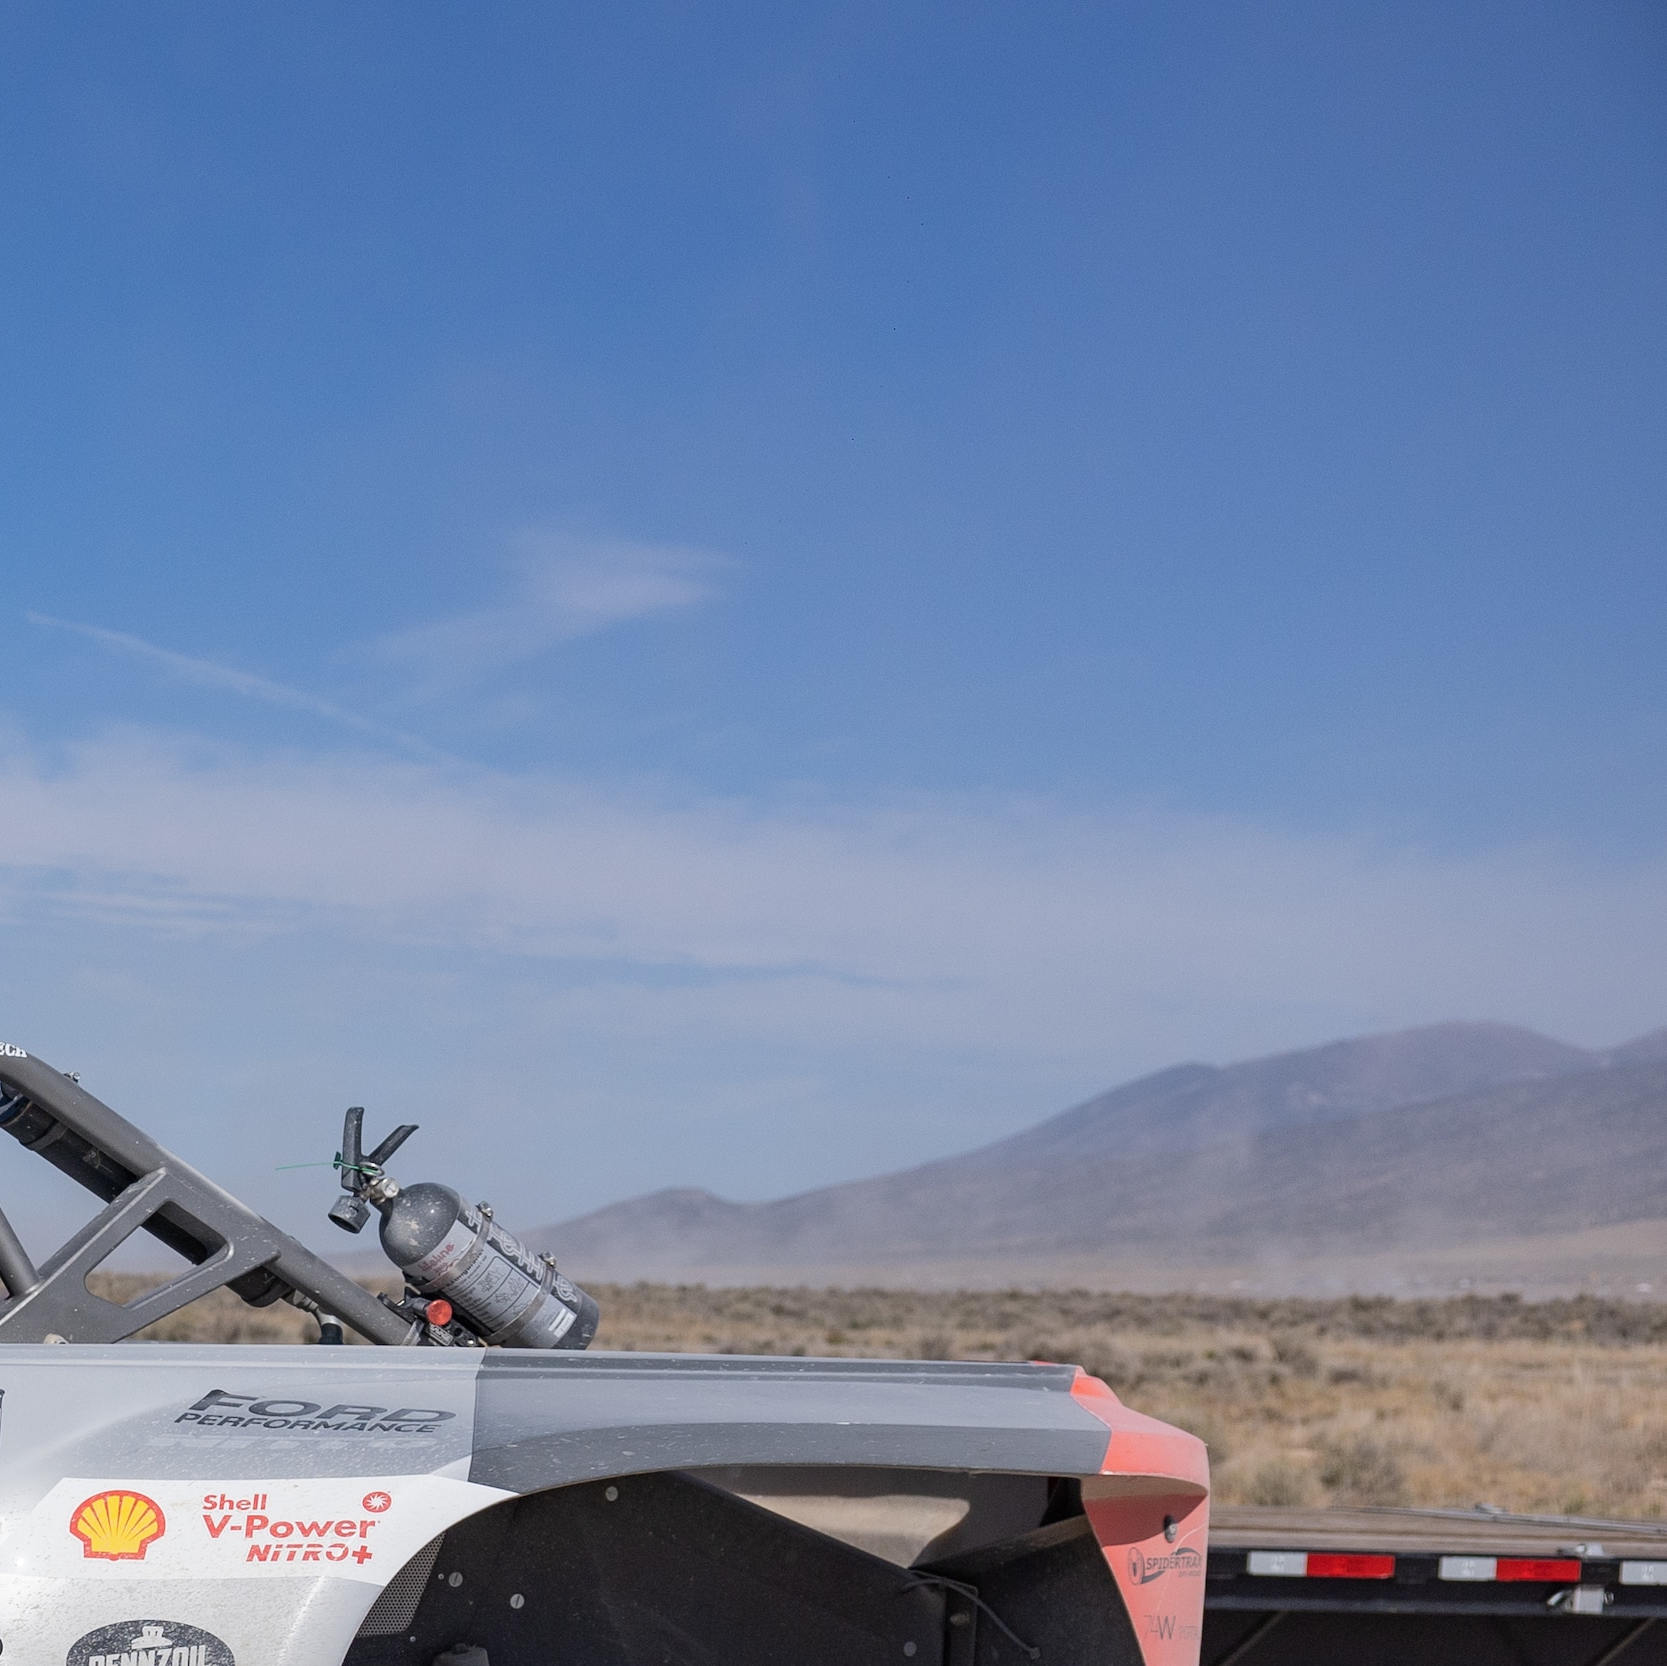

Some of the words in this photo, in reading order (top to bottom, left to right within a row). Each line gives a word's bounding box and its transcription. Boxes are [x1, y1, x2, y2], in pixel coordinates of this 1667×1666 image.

[189, 1389, 457, 1423] FORD
[174, 1411, 442, 1433] PERFORMANCE
[203, 1493, 268, 1511] Shell
[204, 1514, 376, 1539] V-Power
